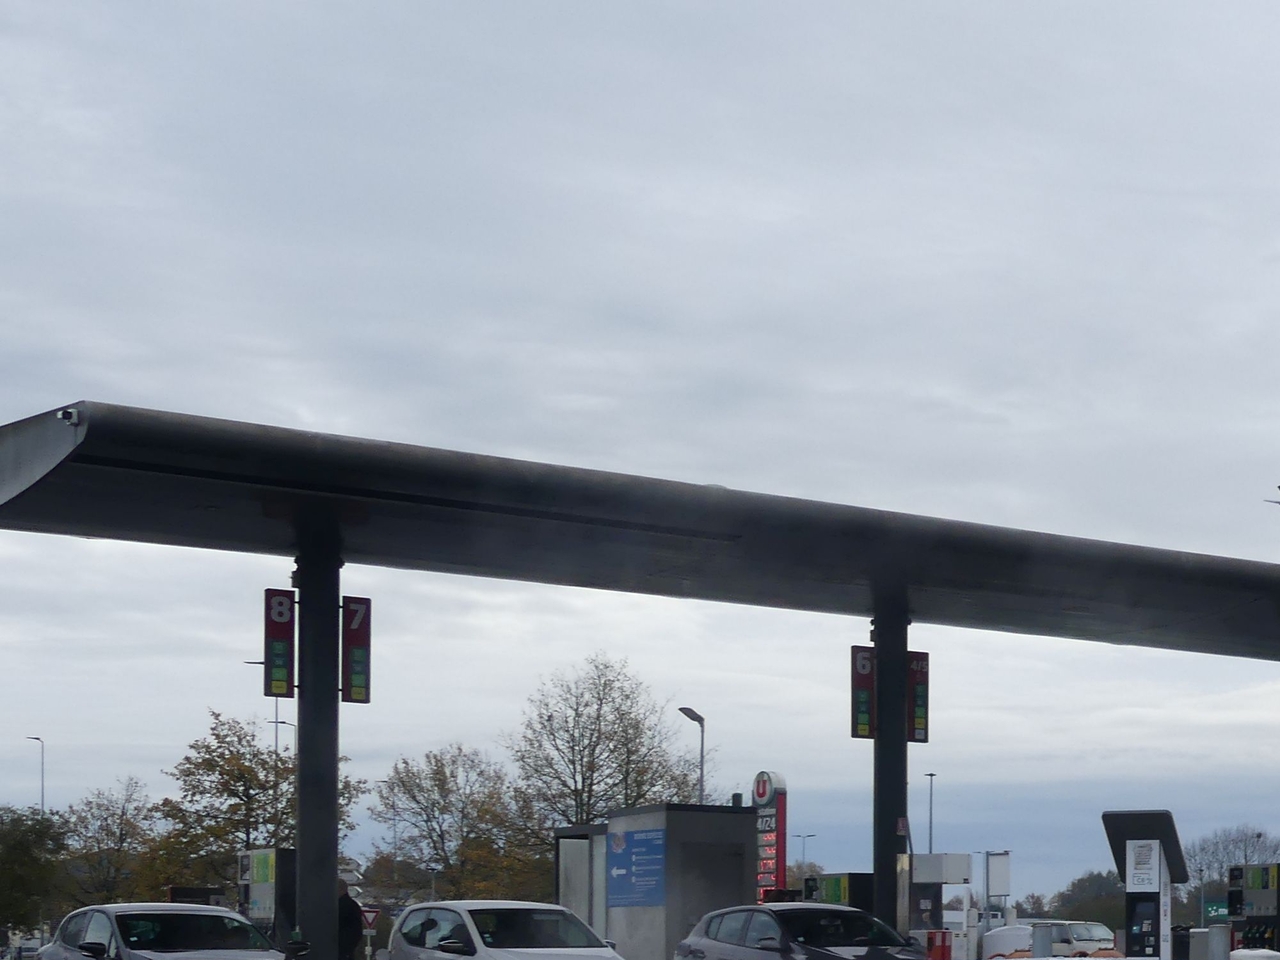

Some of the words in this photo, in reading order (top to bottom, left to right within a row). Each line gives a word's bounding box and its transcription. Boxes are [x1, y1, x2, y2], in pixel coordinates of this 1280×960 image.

[270, 596, 291, 623] 8
[349, 603, 366, 630] 7
[857, 652, 871, 674] 6
[756, 779, 767, 799] U
